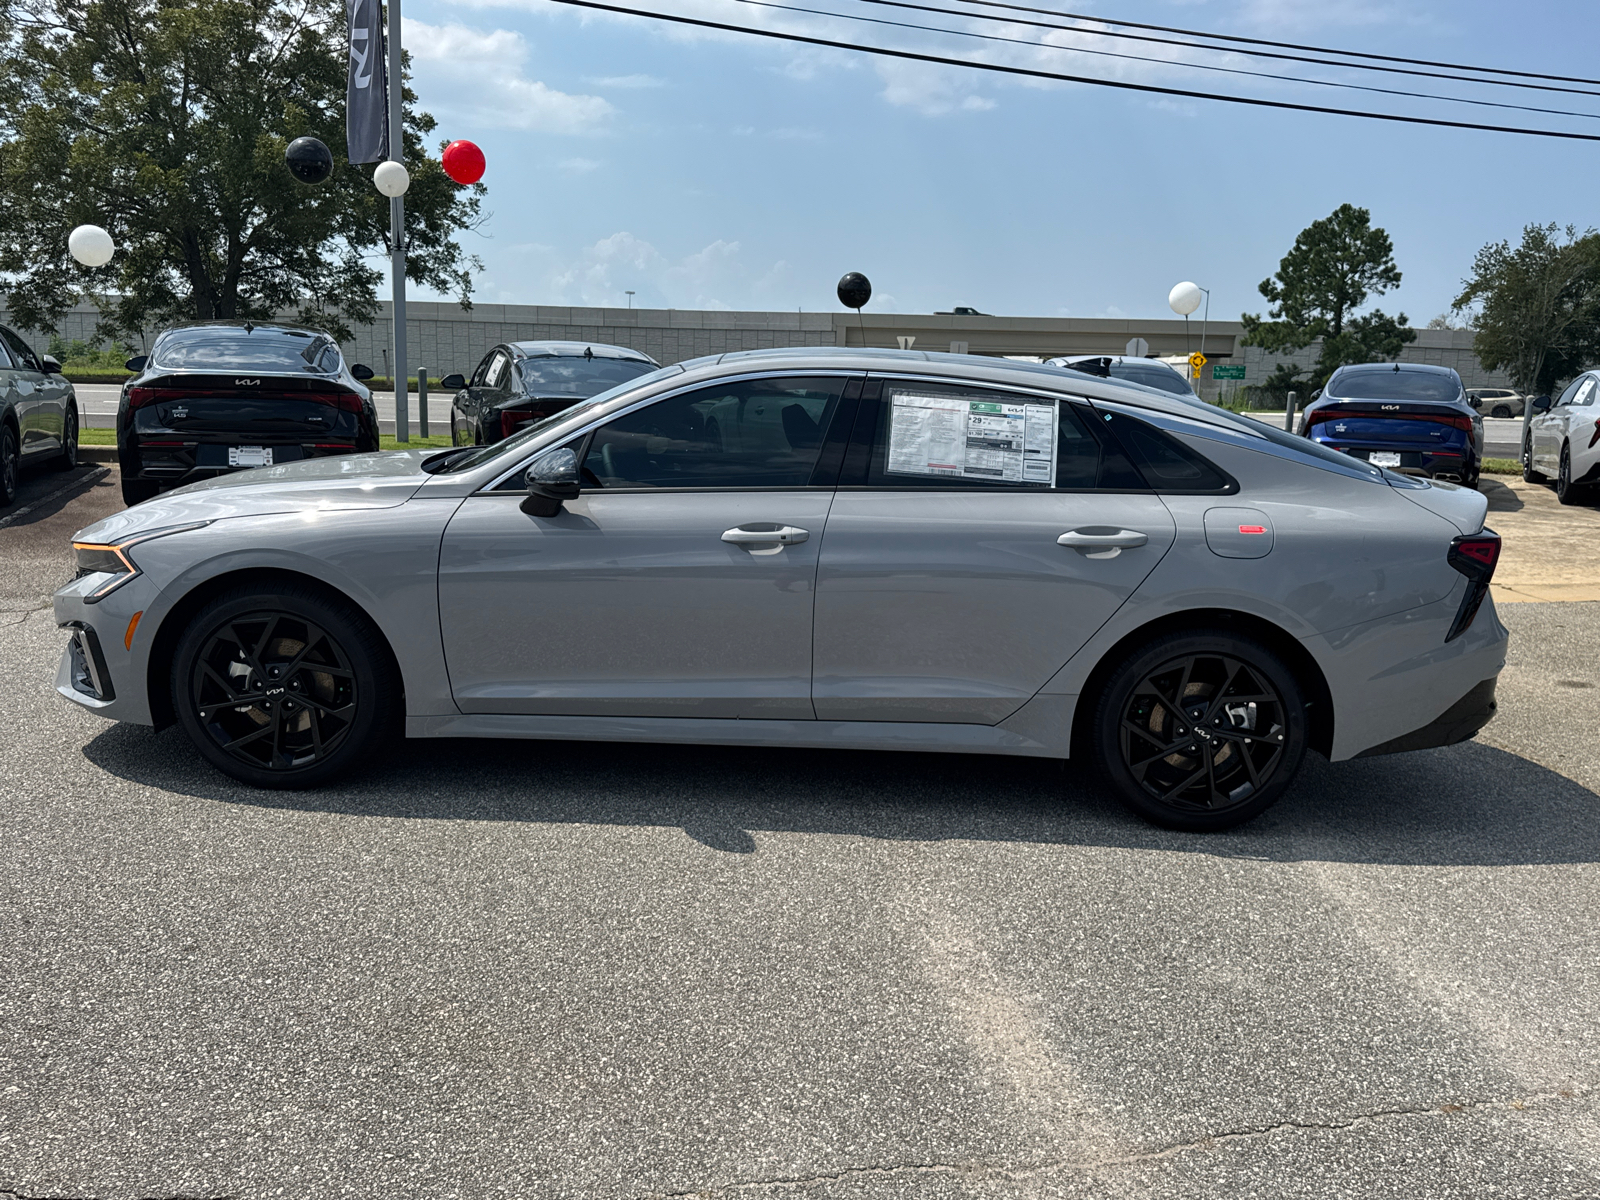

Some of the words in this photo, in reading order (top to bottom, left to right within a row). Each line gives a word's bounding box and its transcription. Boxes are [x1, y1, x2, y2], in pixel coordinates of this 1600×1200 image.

[972, 416, 982, 424] 29
[266, 687, 284, 695] KIA
[1194, 726, 1210, 739] KIA
